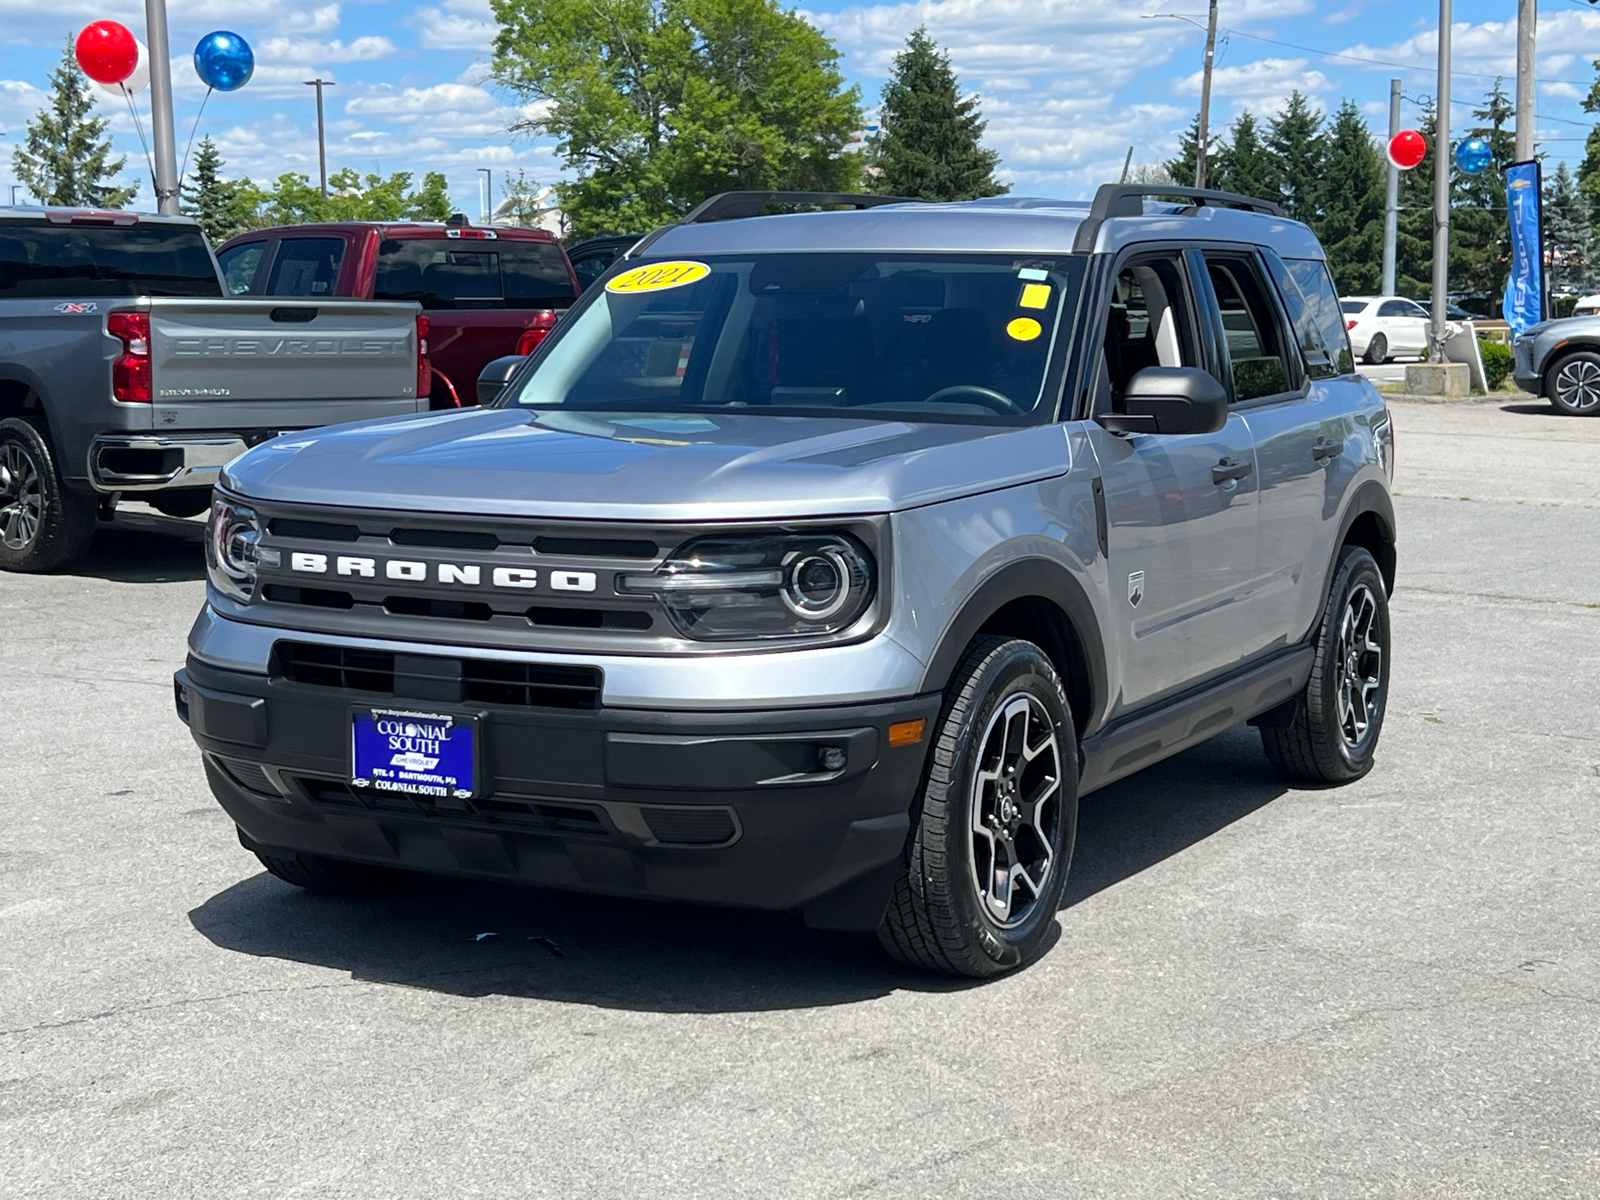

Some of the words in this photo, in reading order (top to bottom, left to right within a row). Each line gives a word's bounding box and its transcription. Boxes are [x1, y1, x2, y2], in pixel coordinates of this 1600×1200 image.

[618, 267, 697, 288] 2021
[175, 339, 404, 355] CHEVROLET
[160, 388, 230, 397] SILVERADO
[291, 552, 597, 592] BRONCO
[377, 720, 452, 741] COLONIAL
[389, 735, 440, 754] SOUTH
[395, 756, 434, 766] CHEVROLET
[399, 771, 445, 784] DARTMOUTH,
[445, 776, 457, 785] MA
[375, 780, 418, 794] COLONIAL
[418, 785, 448, 797] SOUTH
